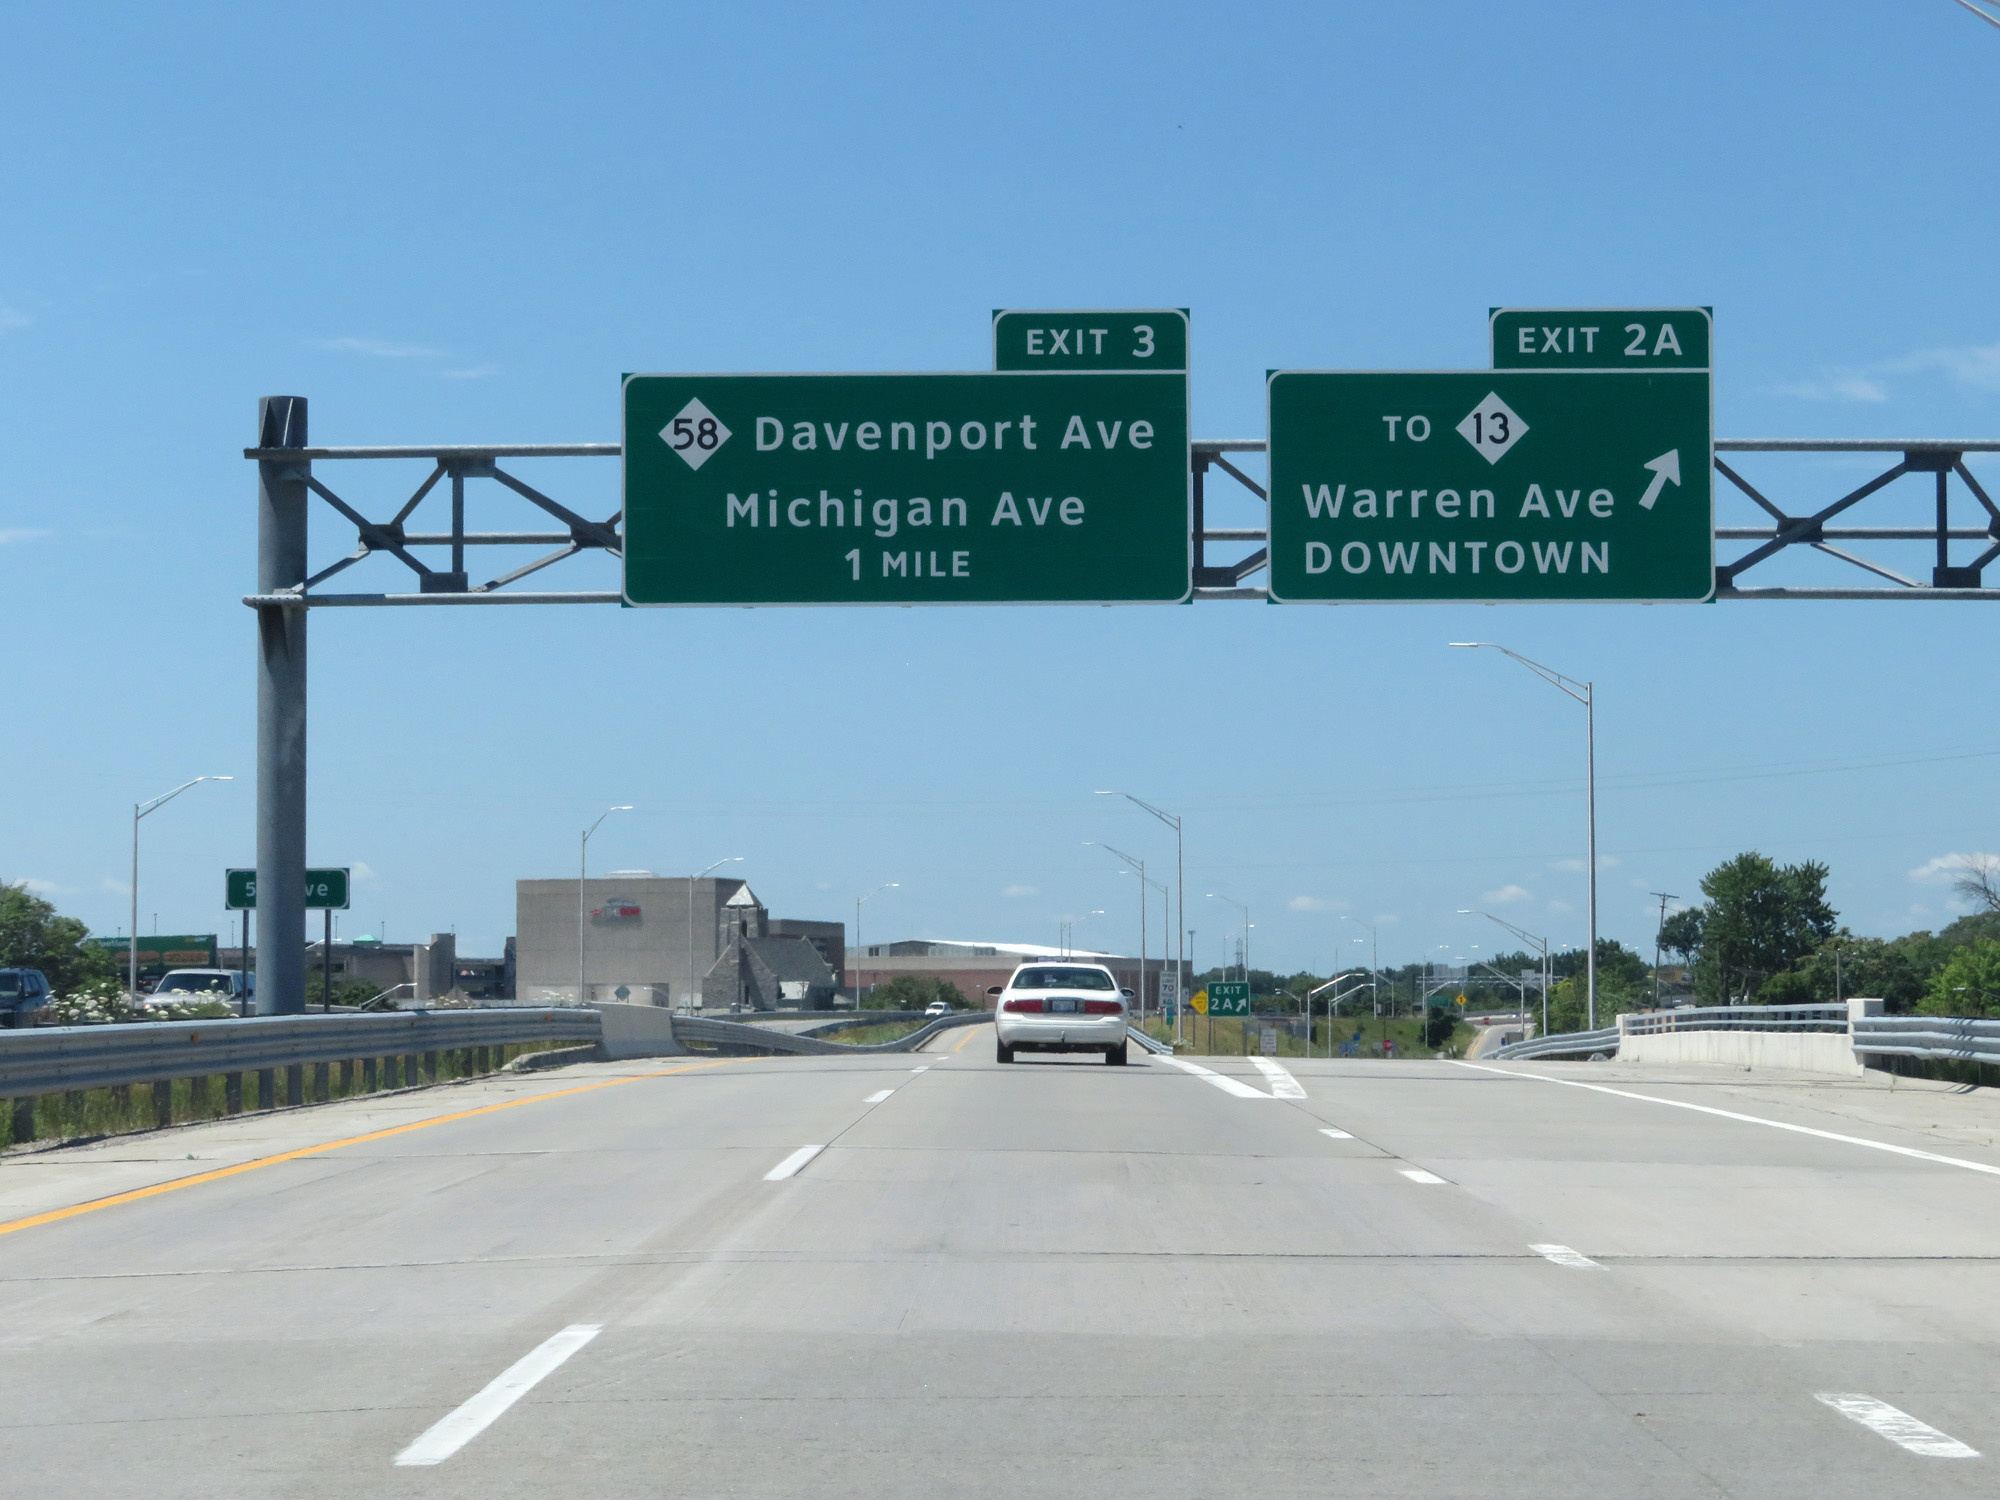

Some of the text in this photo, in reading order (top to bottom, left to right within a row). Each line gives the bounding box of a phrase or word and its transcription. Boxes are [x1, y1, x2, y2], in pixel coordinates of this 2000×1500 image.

[1026, 325, 1155, 358] EXIT 3
[1518, 323, 1683, 356] EXIT 2A
[672, 414, 1155, 459] 58 Davenport Ave
[1383, 412, 1510, 445] TO 13
[726, 488, 1085, 537] Michigan Ave
[1302, 484, 1615, 519] Warren Ave
[844, 548, 970, 581] 1 MILE
[1305, 541, 1610, 574] DOWNTOWN
[306, 883, 329, 897] ve
[1162, 984, 1174, 992] 70
[1210, 998, 1233, 1010] 2A
[1215, 986, 1242, 995] EXIT
